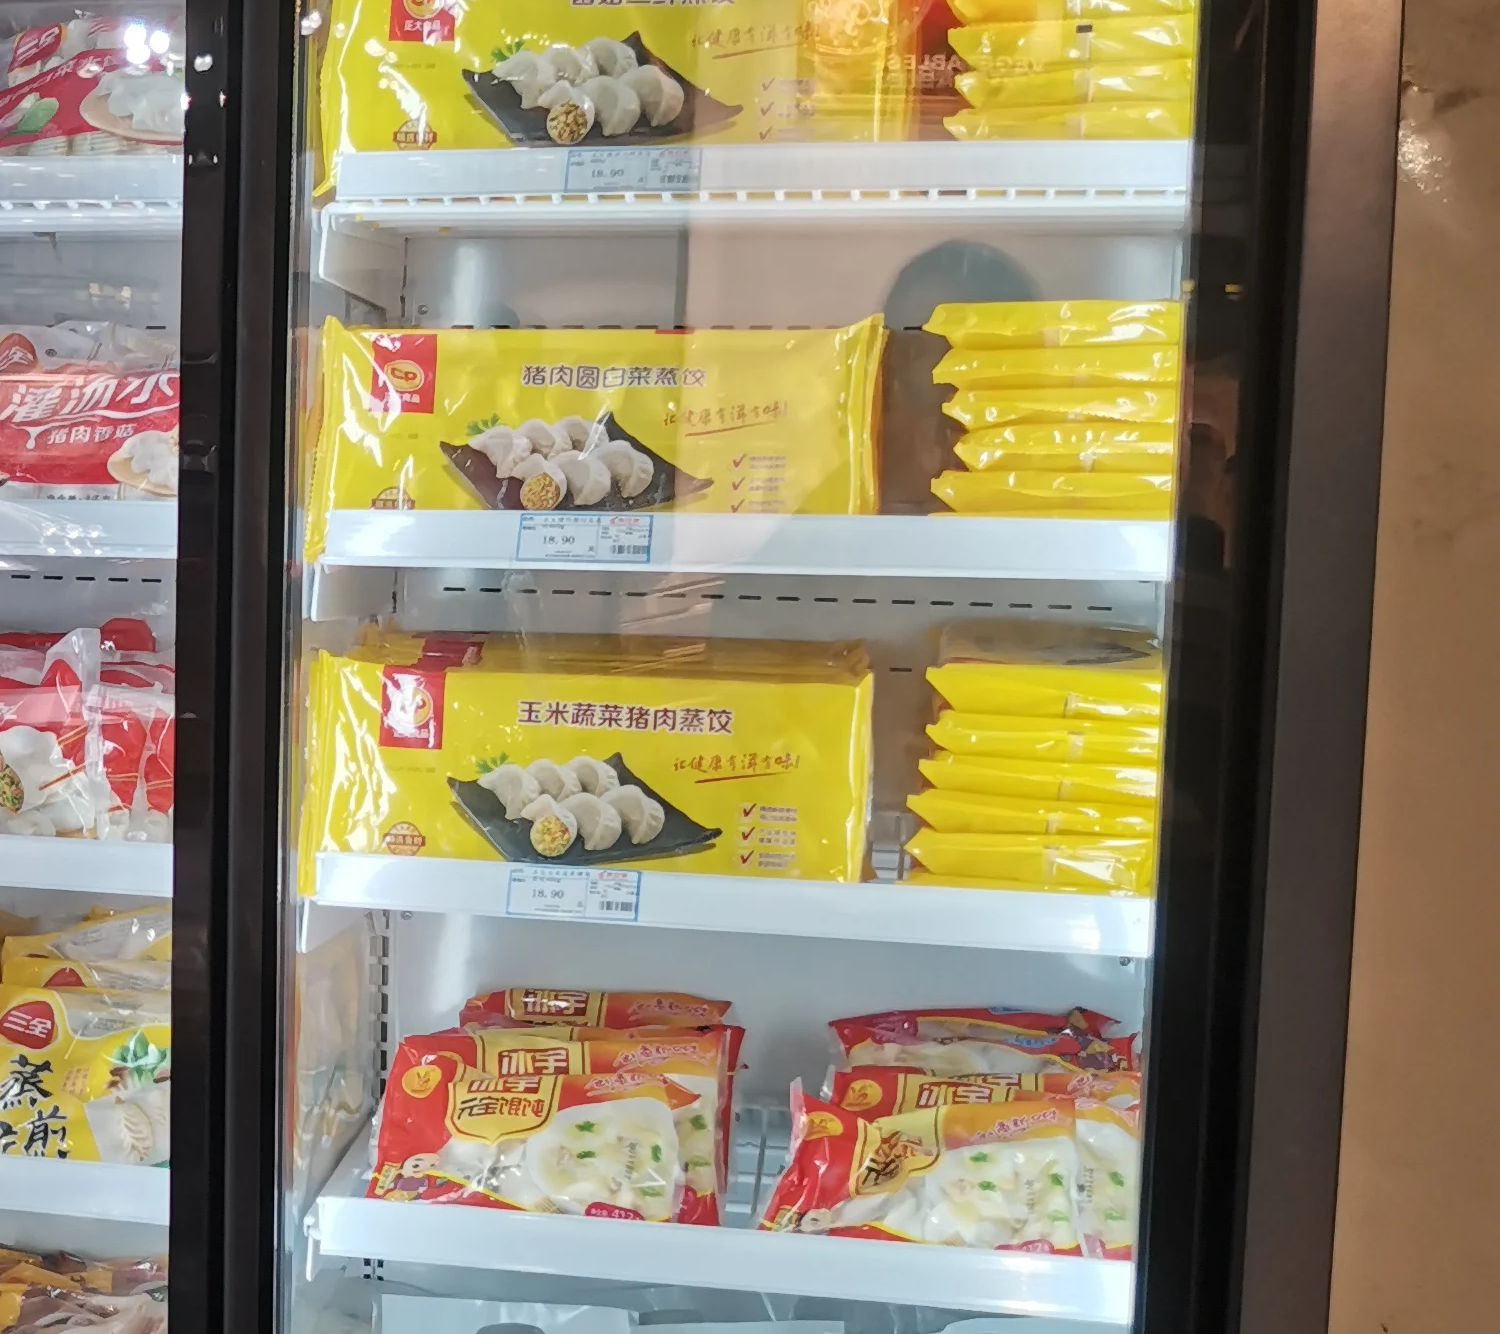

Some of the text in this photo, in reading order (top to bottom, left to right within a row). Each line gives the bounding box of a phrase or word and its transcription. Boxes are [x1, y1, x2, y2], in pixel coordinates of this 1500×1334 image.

[521, 364, 708, 389] 猪肉圆白菜蒸饺
[542, 534, 576, 545] 18.90
[517, 699, 733, 735] 玉米蔬菜猪肉蒸饺
[531, 888, 564, 900] 18.90
[3, 1010, 52, 1039] 三全
[501, 1049, 568, 1076] 冰宇
[457, 1095, 544, 1121] 元宝馄饨
